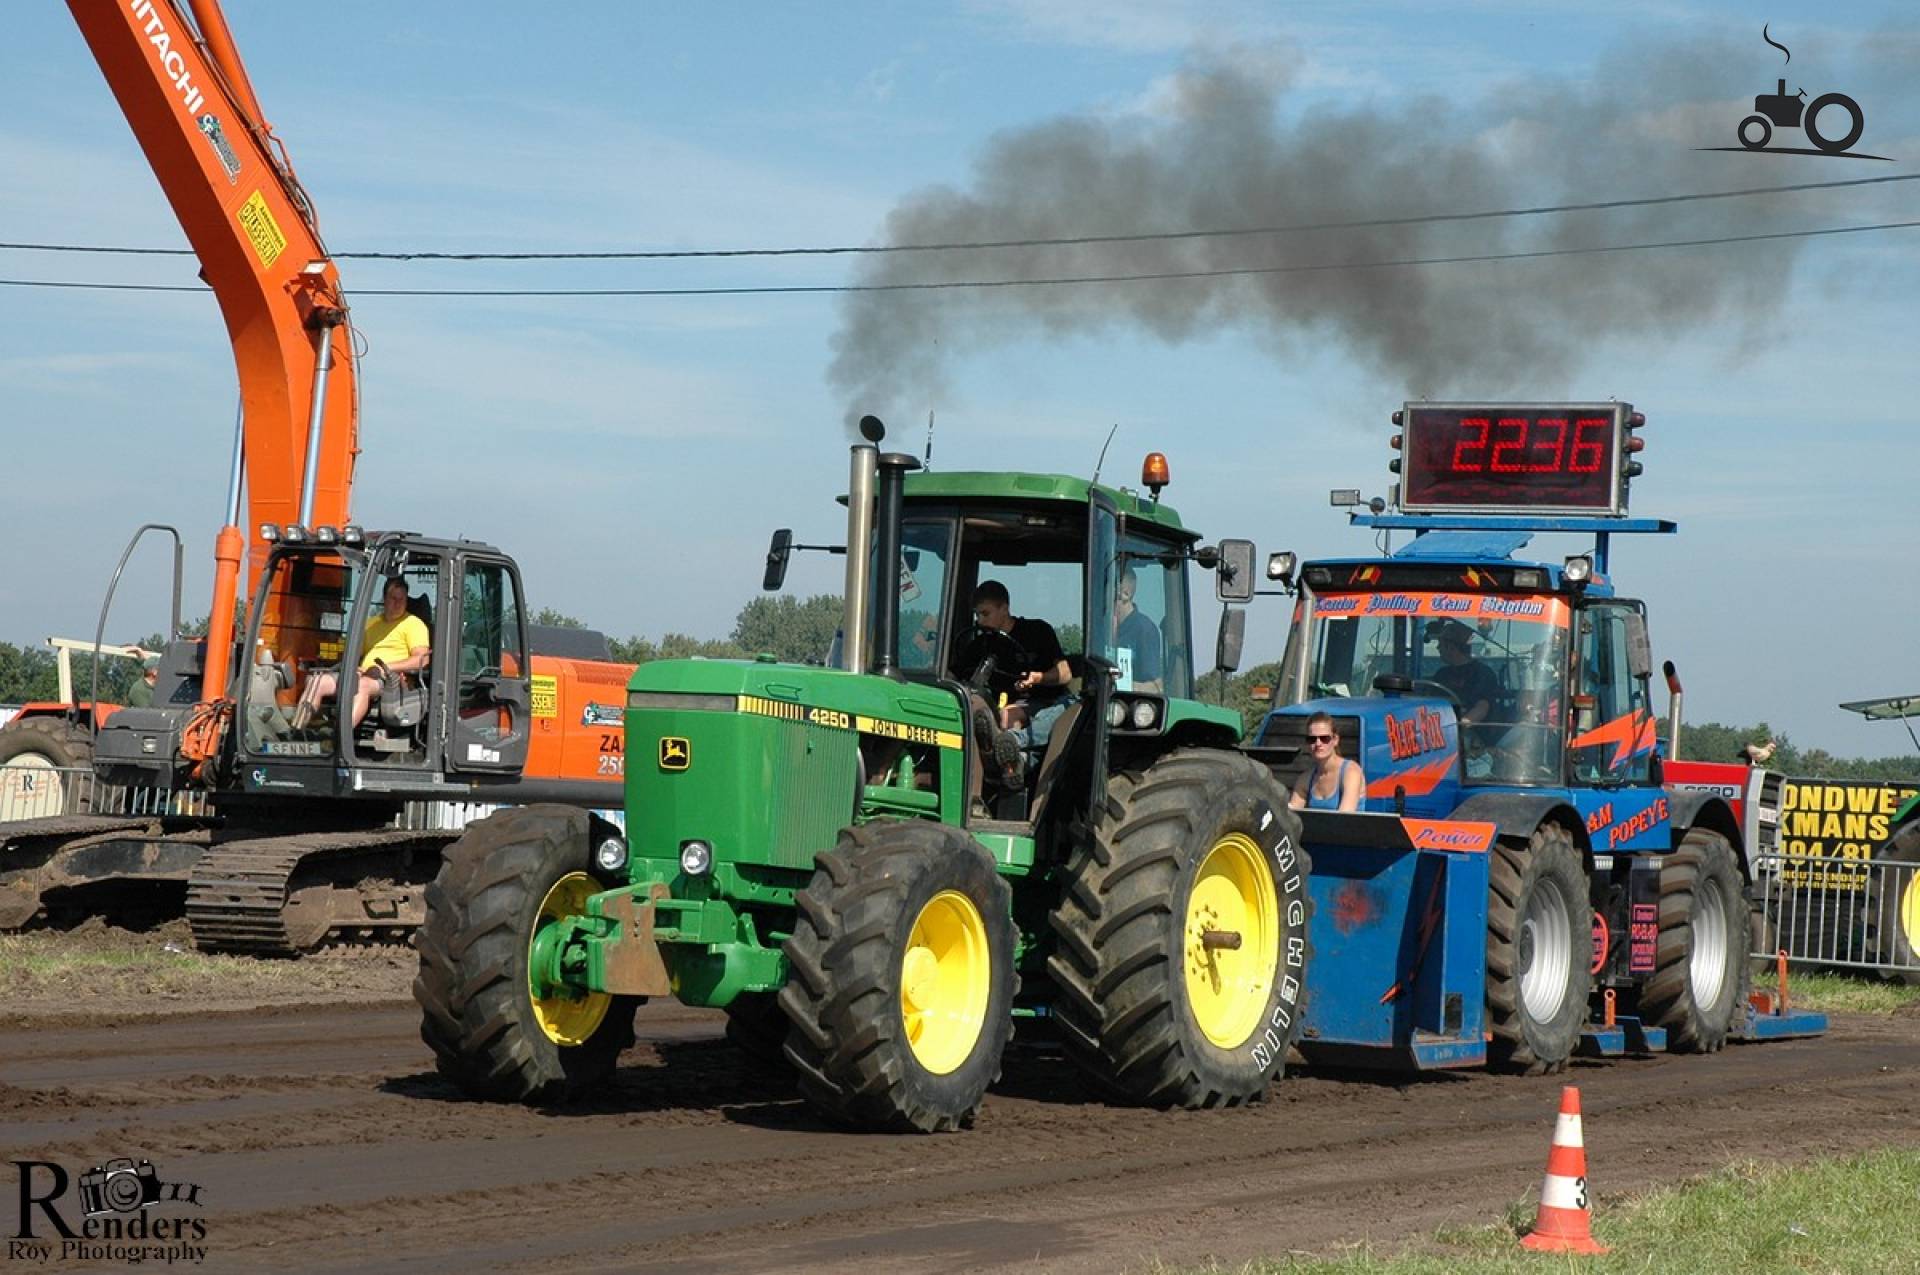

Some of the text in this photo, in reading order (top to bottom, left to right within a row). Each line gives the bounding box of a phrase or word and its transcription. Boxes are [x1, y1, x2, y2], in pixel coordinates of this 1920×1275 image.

[1430, 594, 1471, 611] Team
[1480, 592, 1545, 615] Belgium
[809, 708, 849, 728] 4250
[600, 735, 624, 753] ZA
[872, 719, 939, 745] JOHN DEERE
[1609, 798, 1669, 849] POPEYE
[1576, 1175, 1588, 1209] 3
